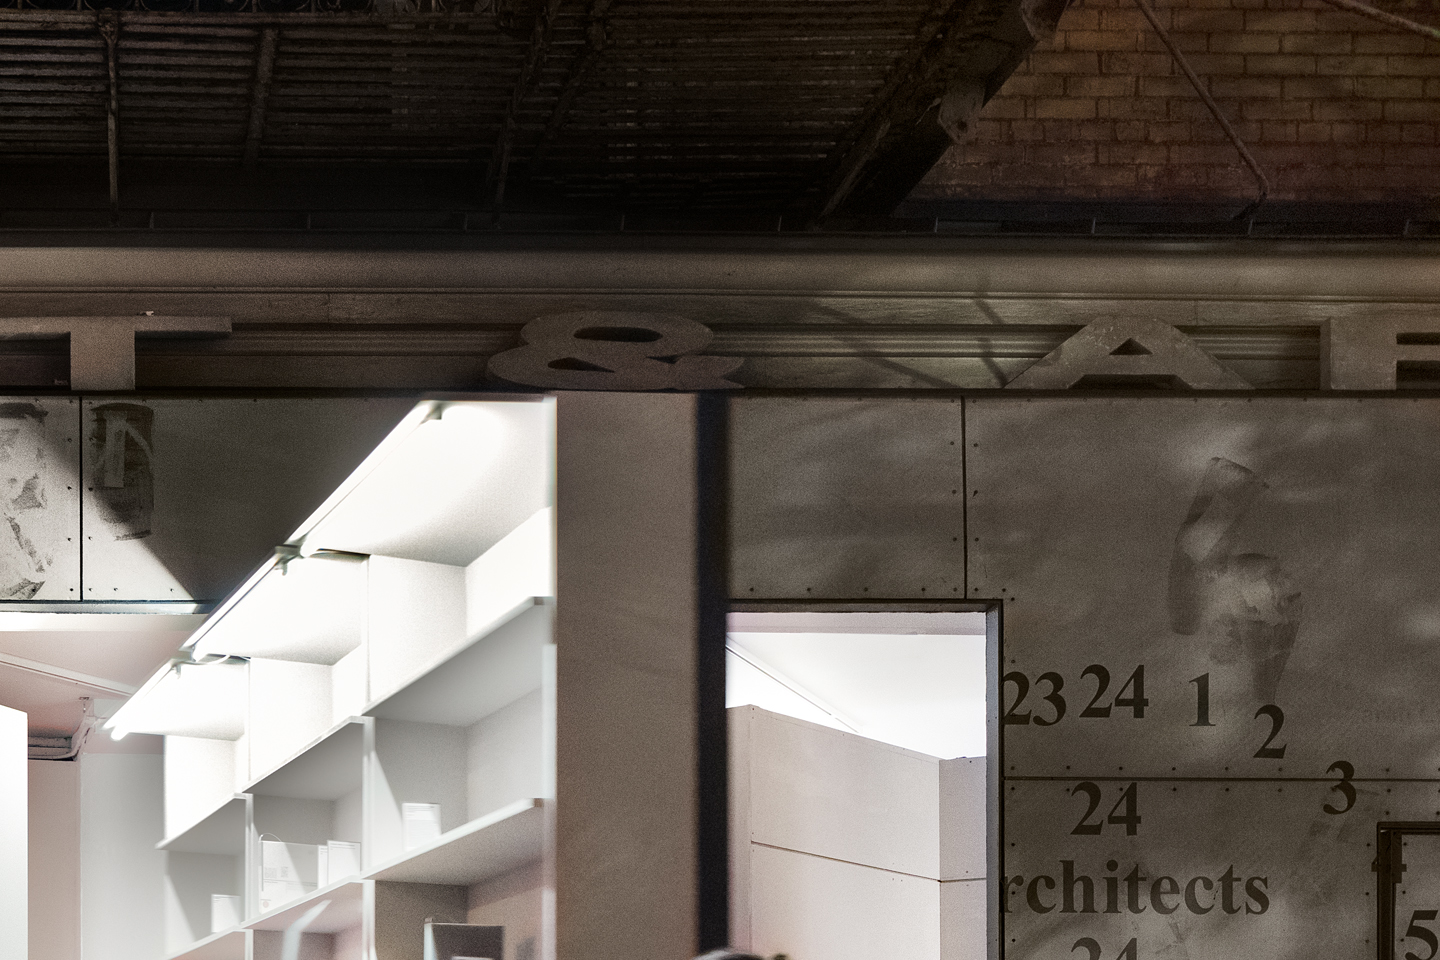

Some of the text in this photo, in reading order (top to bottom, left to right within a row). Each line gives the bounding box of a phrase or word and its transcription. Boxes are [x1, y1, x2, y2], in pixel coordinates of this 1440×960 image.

[486, 310, 746, 391] &
[1001, 671, 1216, 727] 23 1
[1078, 664, 1149, 719] 24
[1253, 704, 1288, 759] 2
[1069, 781, 1142, 836] 24
[1322, 760, 1357, 815] 3
